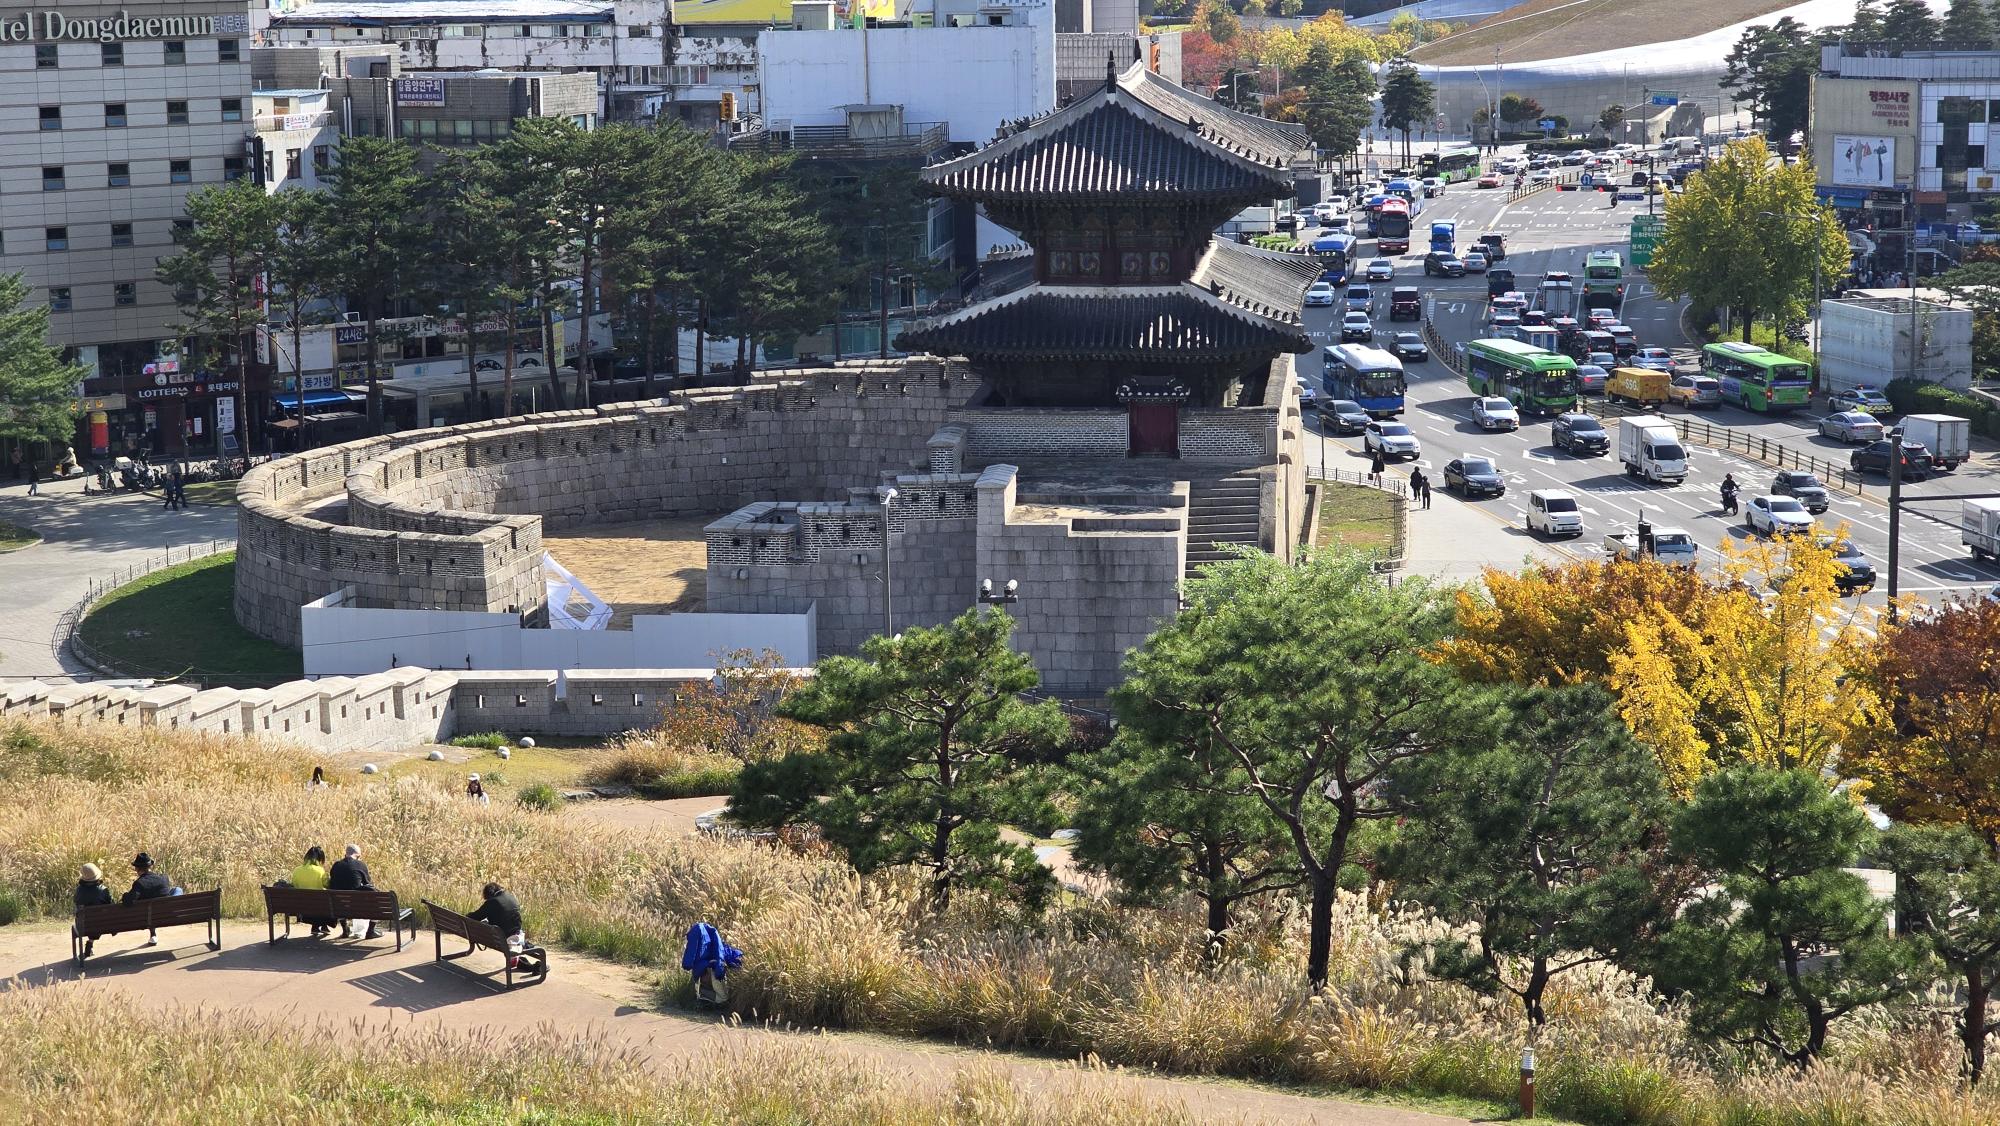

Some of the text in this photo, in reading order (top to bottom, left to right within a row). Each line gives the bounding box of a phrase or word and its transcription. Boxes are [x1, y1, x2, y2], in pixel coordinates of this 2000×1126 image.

[44, 10, 214, 42] Dongdaemun
[1869, 90, 1910, 103] 평화시장
[339, 327, 364, 341] 24시간
[1547, 369, 1566, 377] 7212
